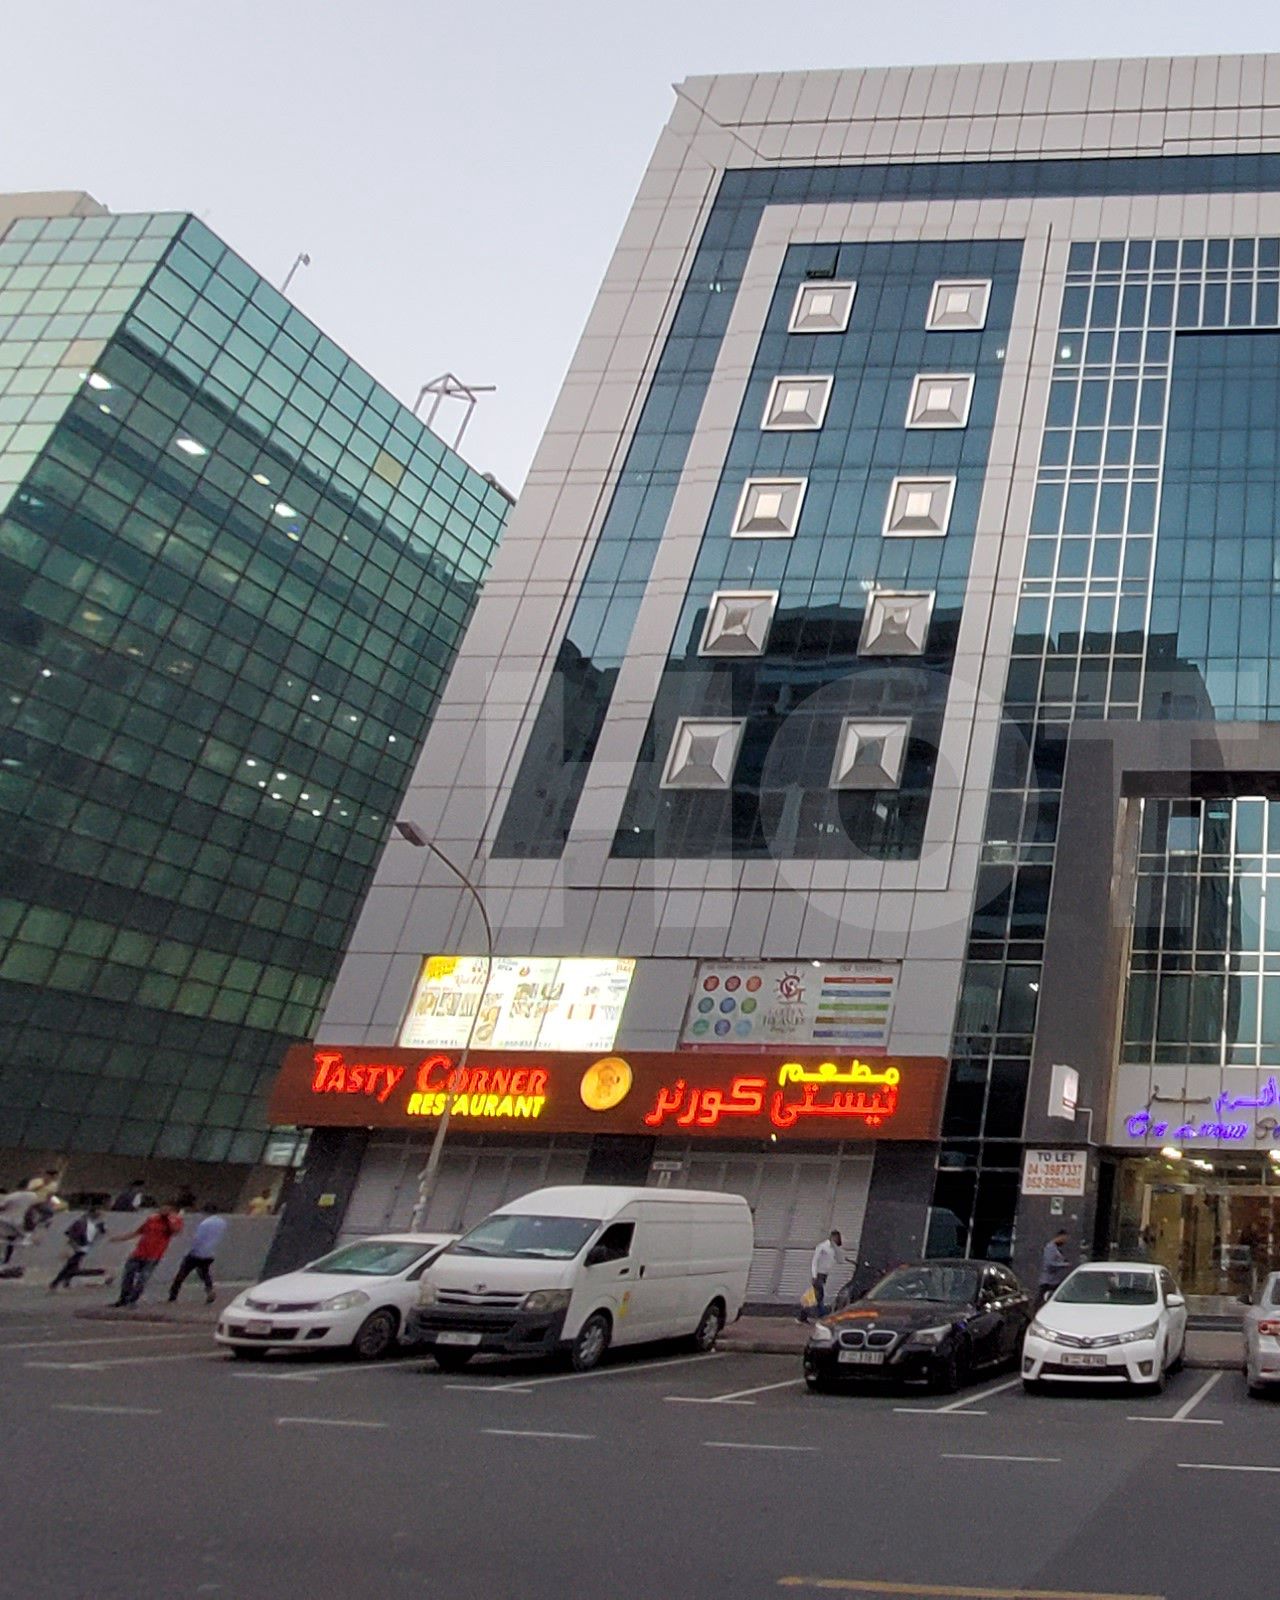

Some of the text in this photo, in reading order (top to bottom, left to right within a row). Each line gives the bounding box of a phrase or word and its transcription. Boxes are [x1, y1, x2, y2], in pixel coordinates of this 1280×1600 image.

[312, 1052, 547, 1102] TASTY CORNER
[778, 1060, 900, 1085] مطعم
[407, 1093, 546, 1117] RESAURANT
[645, 1077, 767, 1127] كورنر
[1037, 1152, 1075, 1162] TO LET
